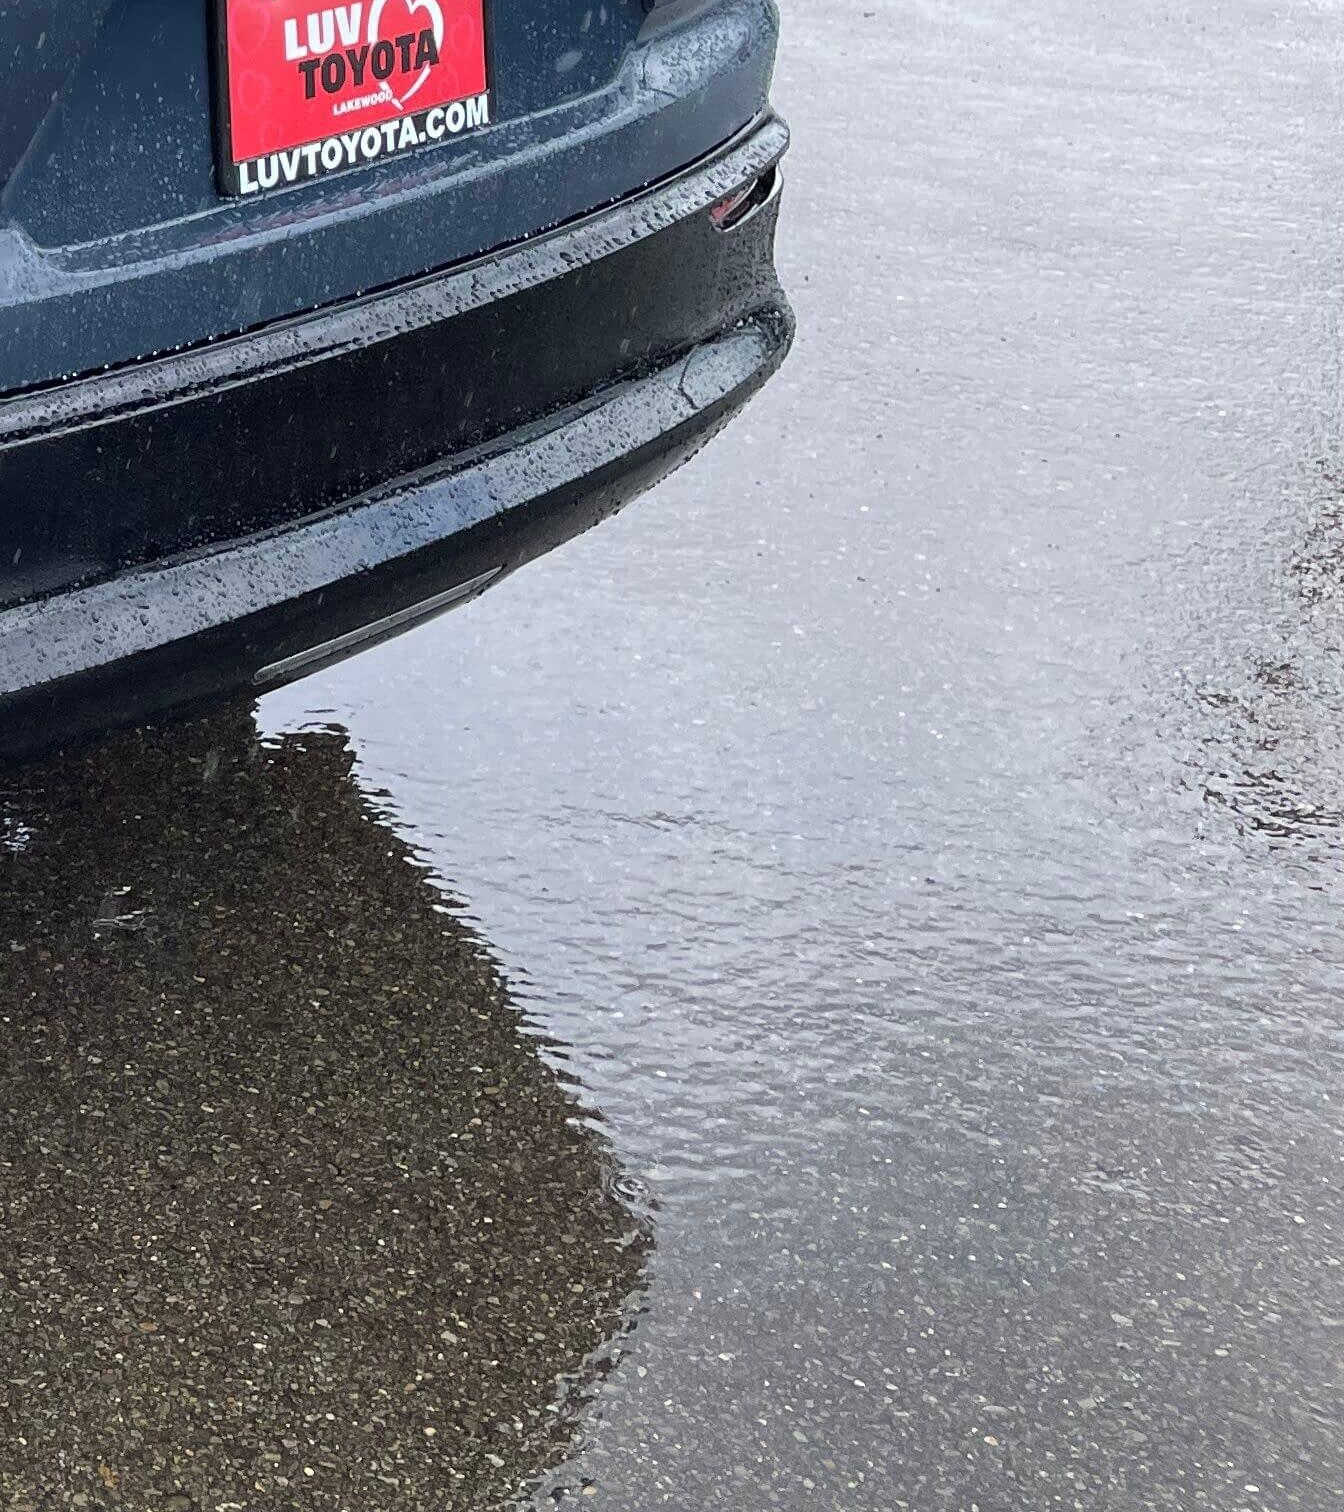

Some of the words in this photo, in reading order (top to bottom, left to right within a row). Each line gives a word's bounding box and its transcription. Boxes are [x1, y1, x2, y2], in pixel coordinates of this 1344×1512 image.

[284, 2, 362, 61] LUV
[298, 29, 440, 100] TOYOTA
[333, 90, 393, 116] LAKEWOOD
[239, 94, 489, 194] LUVTOYOTA.COM
